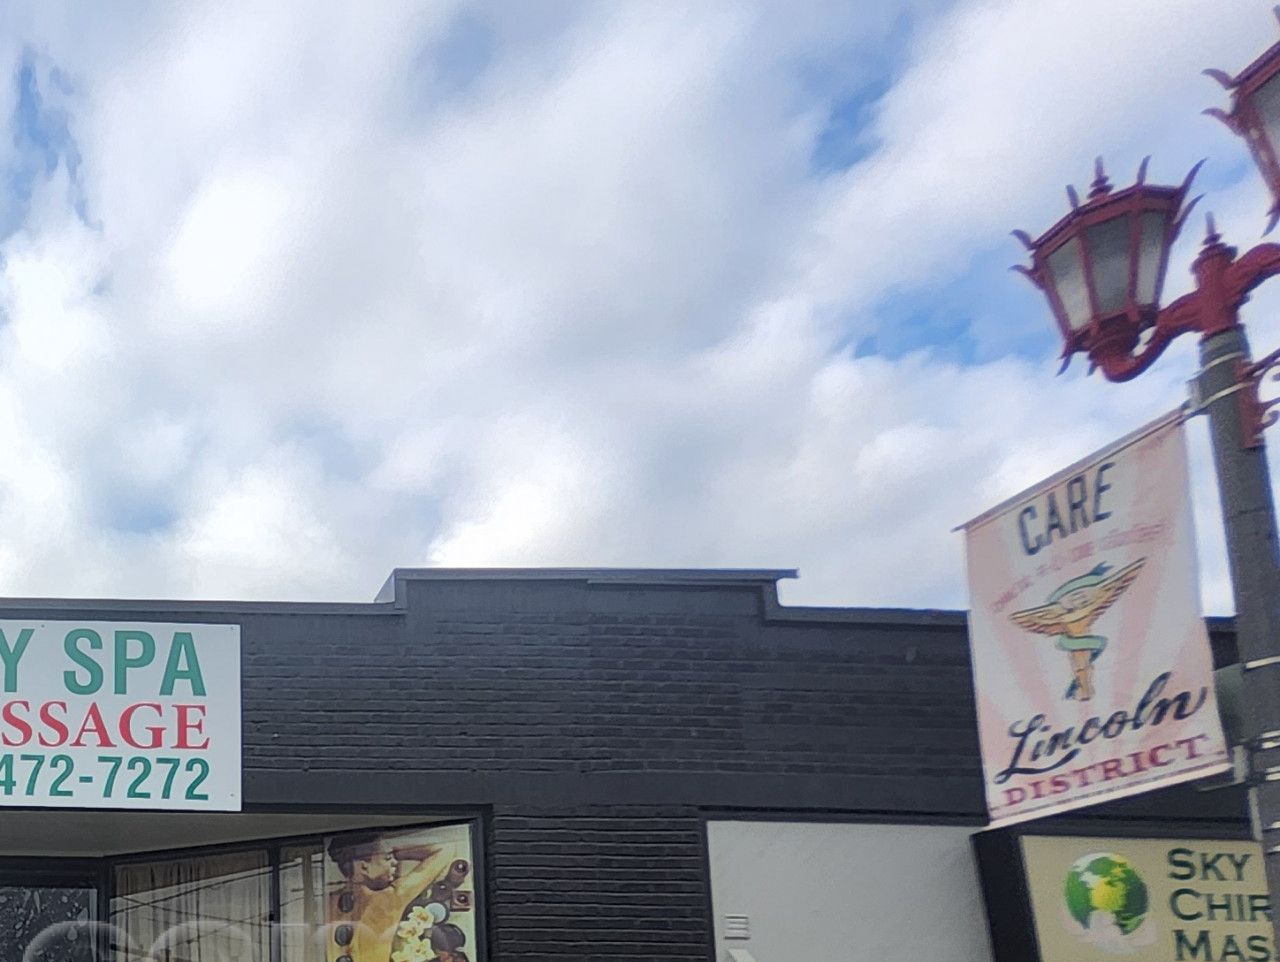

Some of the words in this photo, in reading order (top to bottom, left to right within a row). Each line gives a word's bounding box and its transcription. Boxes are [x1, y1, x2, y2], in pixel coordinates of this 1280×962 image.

[1019, 462, 1116, 555] CARE
[63, 628, 207, 697] SPA
[994, 672, 1208, 785] Lincoln
[1002, 733, 1210, 807] DISTRICT
[1167, 847, 1253, 881] SKY
